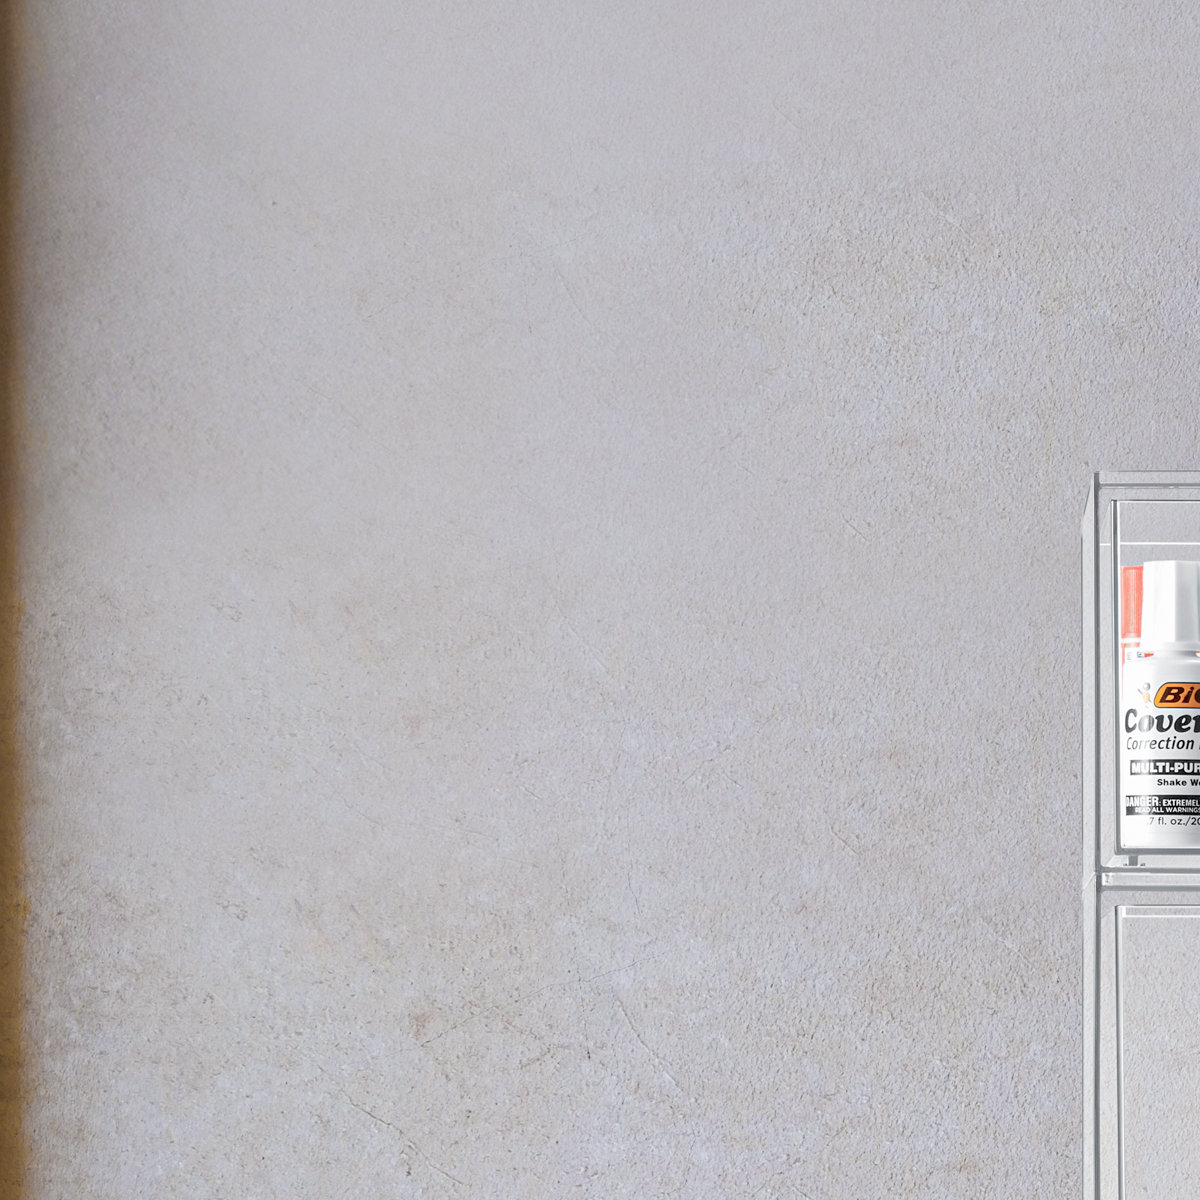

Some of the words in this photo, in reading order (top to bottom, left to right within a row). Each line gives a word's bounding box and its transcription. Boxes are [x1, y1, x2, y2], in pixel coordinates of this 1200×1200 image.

[1126, 736, 1194, 750] Correction
[1157, 779, 1187, 787] Shake
[1158, 816, 1167, 825] fl.
